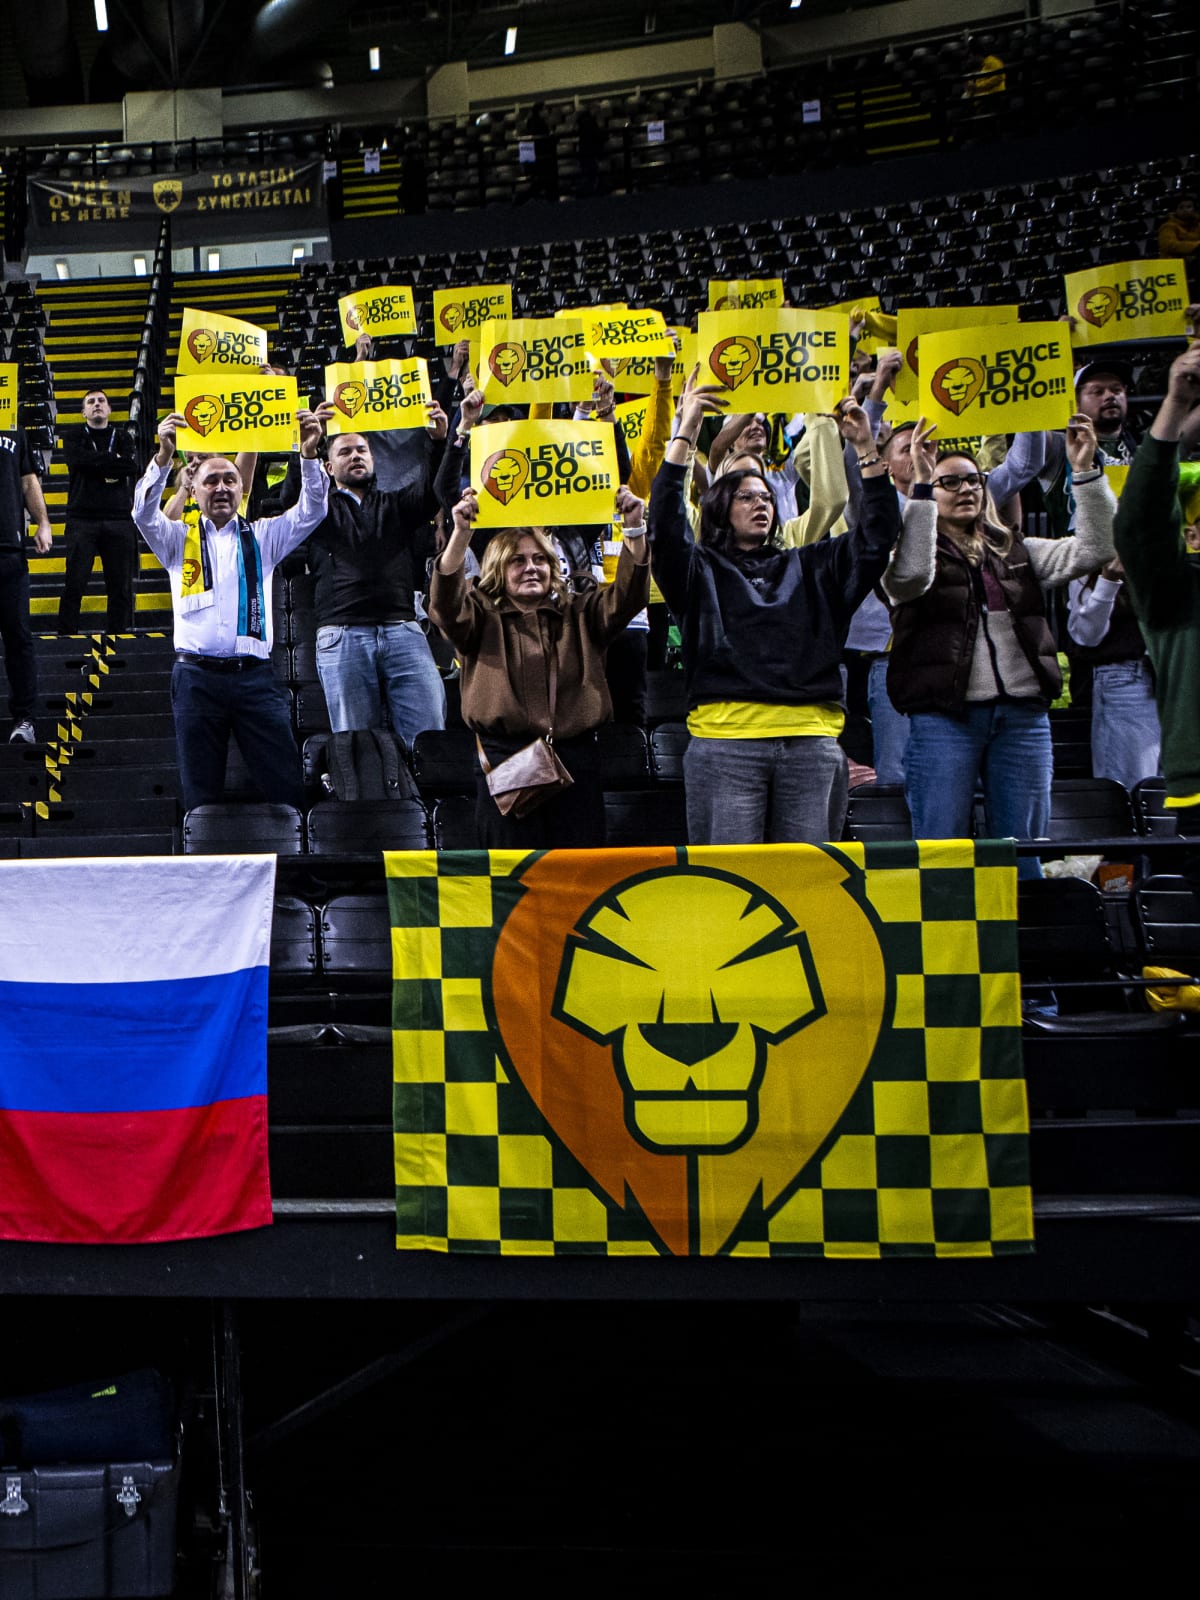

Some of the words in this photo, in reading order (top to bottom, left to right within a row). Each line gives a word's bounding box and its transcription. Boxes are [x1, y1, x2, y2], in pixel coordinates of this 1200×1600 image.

[71, 180, 109, 191] THE
[49, 191, 131, 209] QUEEN
[51, 211, 70, 222] IS
[78, 206, 130, 221] HERE
[1115, 273, 1176, 293] LEVICE
[365, 294, 406, 308] LEVICE
[461, 295, 504, 309] LEVICE
[737, 289, 777, 301] LEVICE
[1120, 288, 1158, 309] DO
[365, 310, 410, 325] TOHO!!!
[367, 304, 393, 317] DO
[464, 305, 490, 318] DO
[1115, 298, 1182, 322] TOHO!!!
[599, 317, 656, 329] LEVICE
[215, 330, 260, 347] LEVICE
[602, 332, 664, 345] TOHO!!!
[604, 327, 638, 339] DO
[756, 331, 836, 350] LEVICE
[217, 338, 246, 354] DO
[522, 333, 585, 352] LEVICE
[211, 352, 263, 366] TOHO!!!
[526, 349, 564, 366] DO
[760, 346, 810, 369] DO
[980, 342, 1060, 370] LEVICE
[521, 360, 590, 383] TOHO!!!
[626, 363, 684, 376] TOH!!!
[753, 365, 840, 386] TOHO!!!
[986, 362, 1036, 391] DO
[363, 370, 421, 388] LEVICE
[220, 388, 286, 404] LEVICE
[367, 384, 402, 401] DO
[978, 377, 1066, 408] TOHO!!!
[224, 401, 263, 419] DO
[363, 393, 426, 413] TOHO!!!
[219, 412, 291, 432] TOHO!!!
[525, 440, 604, 462] LEVICE
[529, 457, 578, 482] DO
[522, 473, 611, 500] TOHO!!!
